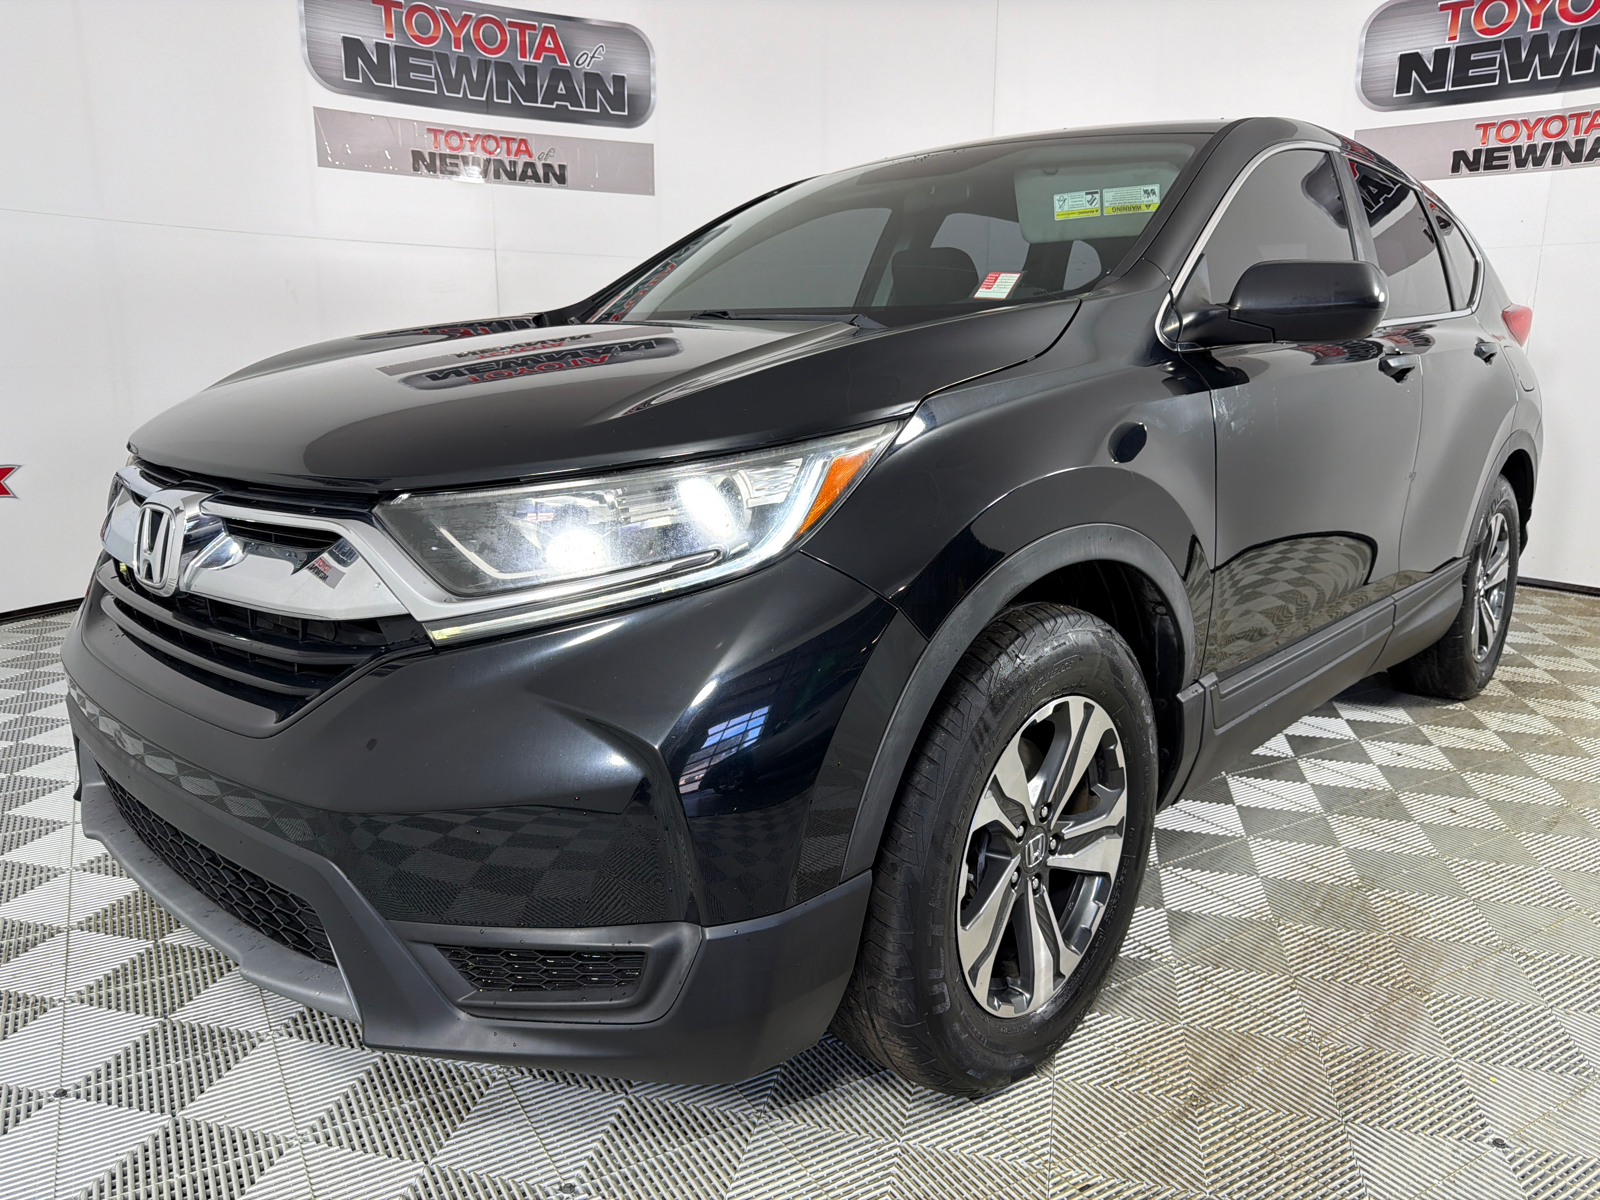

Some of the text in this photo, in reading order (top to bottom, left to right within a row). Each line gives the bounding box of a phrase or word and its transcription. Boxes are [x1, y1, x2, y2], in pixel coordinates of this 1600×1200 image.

[371, 0, 606, 69] TOYOTA of
[340, 34, 629, 116] NEWNAN
[426, 127, 556, 163] TOYOTA of
[410, 149, 568, 186] NEWNAN
[1111, 204, 1142, 213] WARNING
